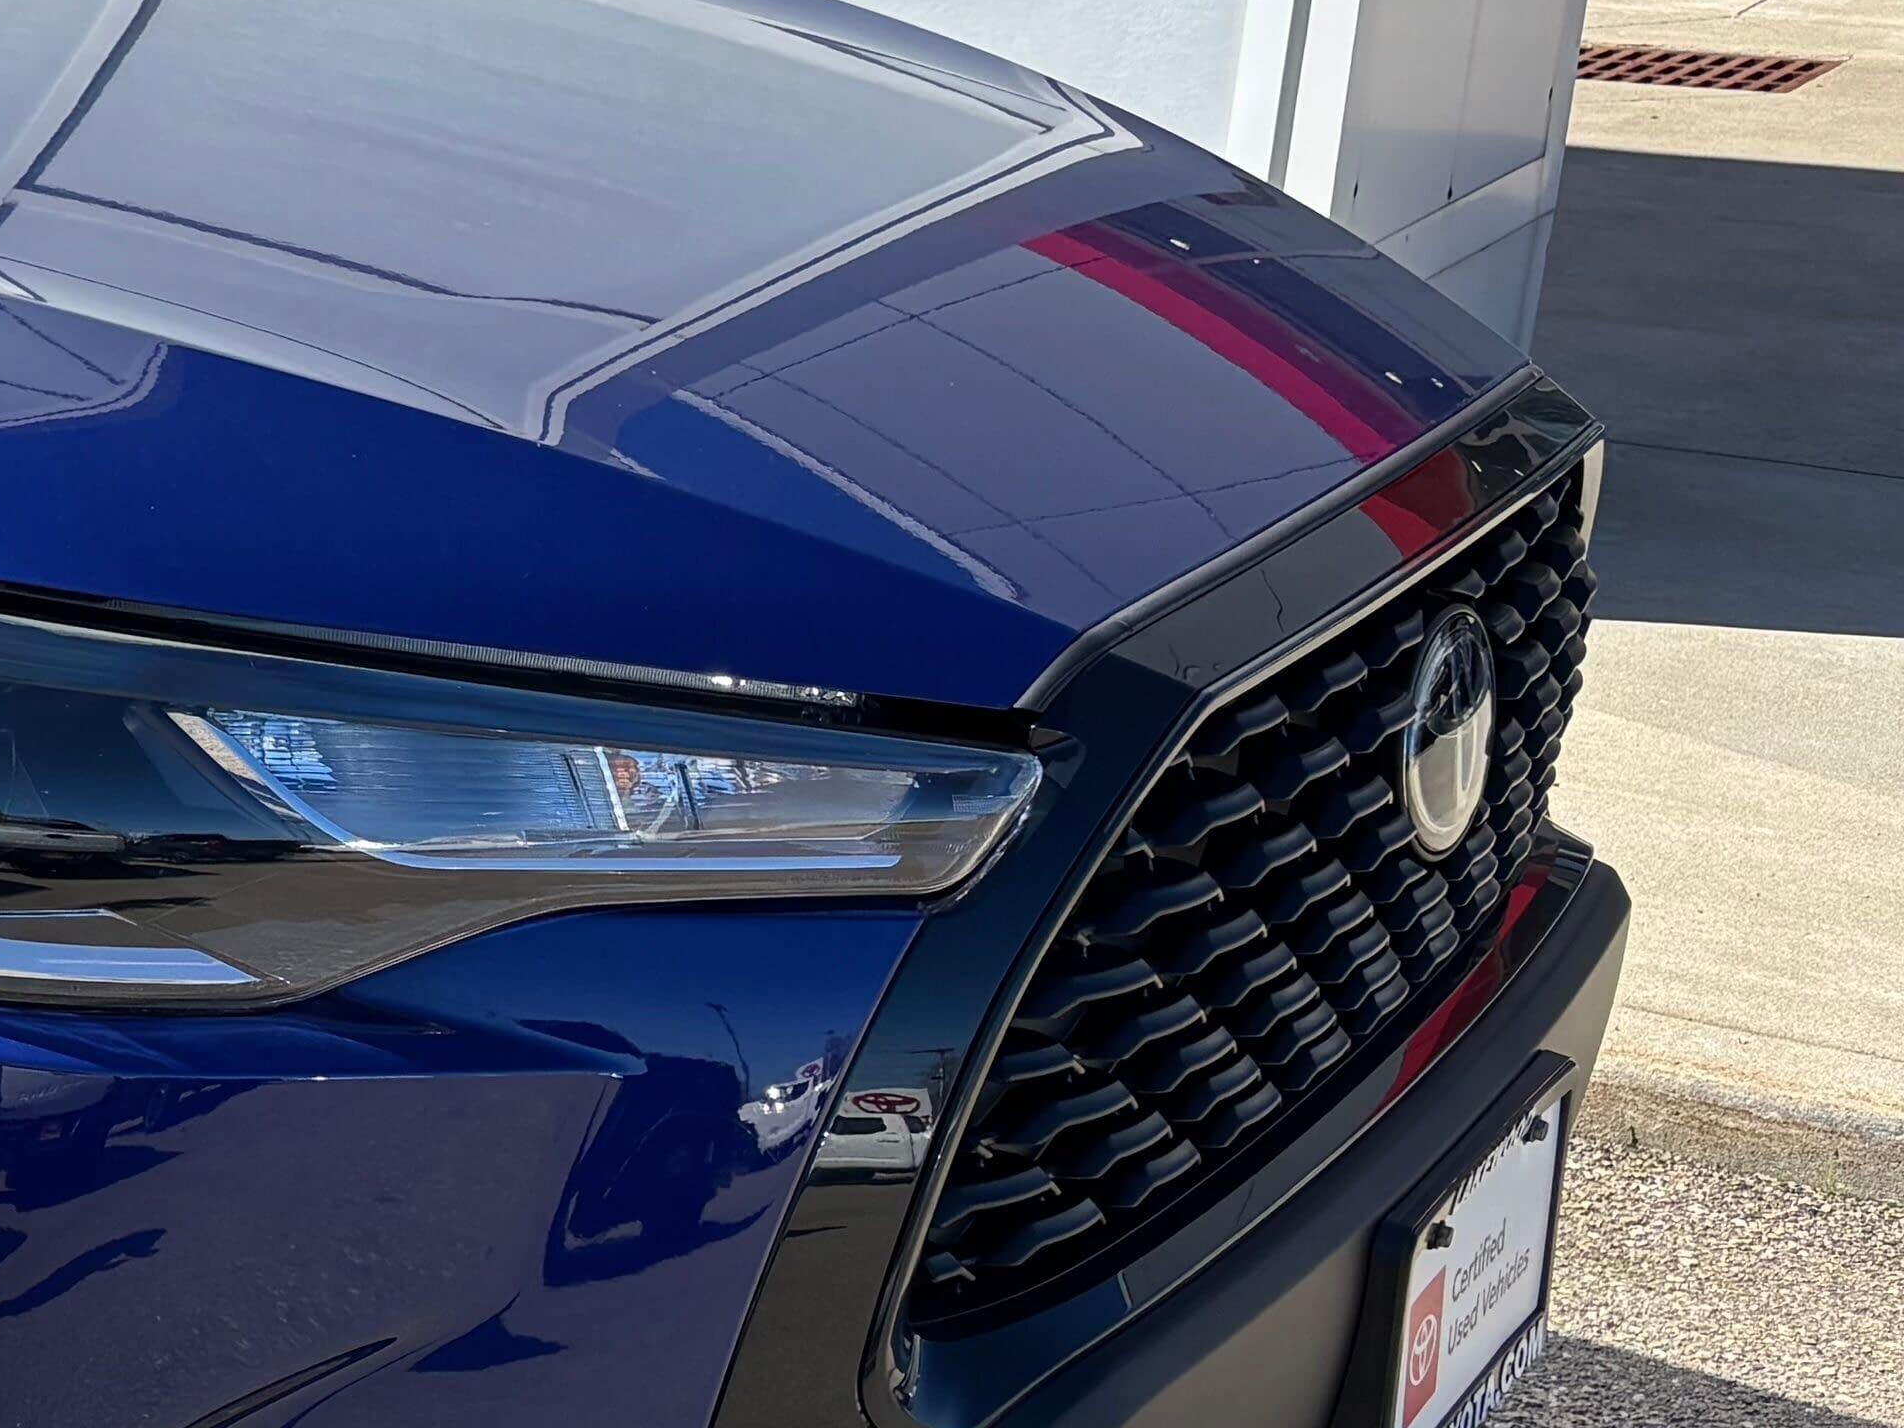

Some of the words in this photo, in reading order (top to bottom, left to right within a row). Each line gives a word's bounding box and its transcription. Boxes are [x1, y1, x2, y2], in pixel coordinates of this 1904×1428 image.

[1448, 1291, 1481, 1355] Used
[1482, 1247, 1530, 1316] Vehicles
[1452, 1217, 1507, 1302] Certified
